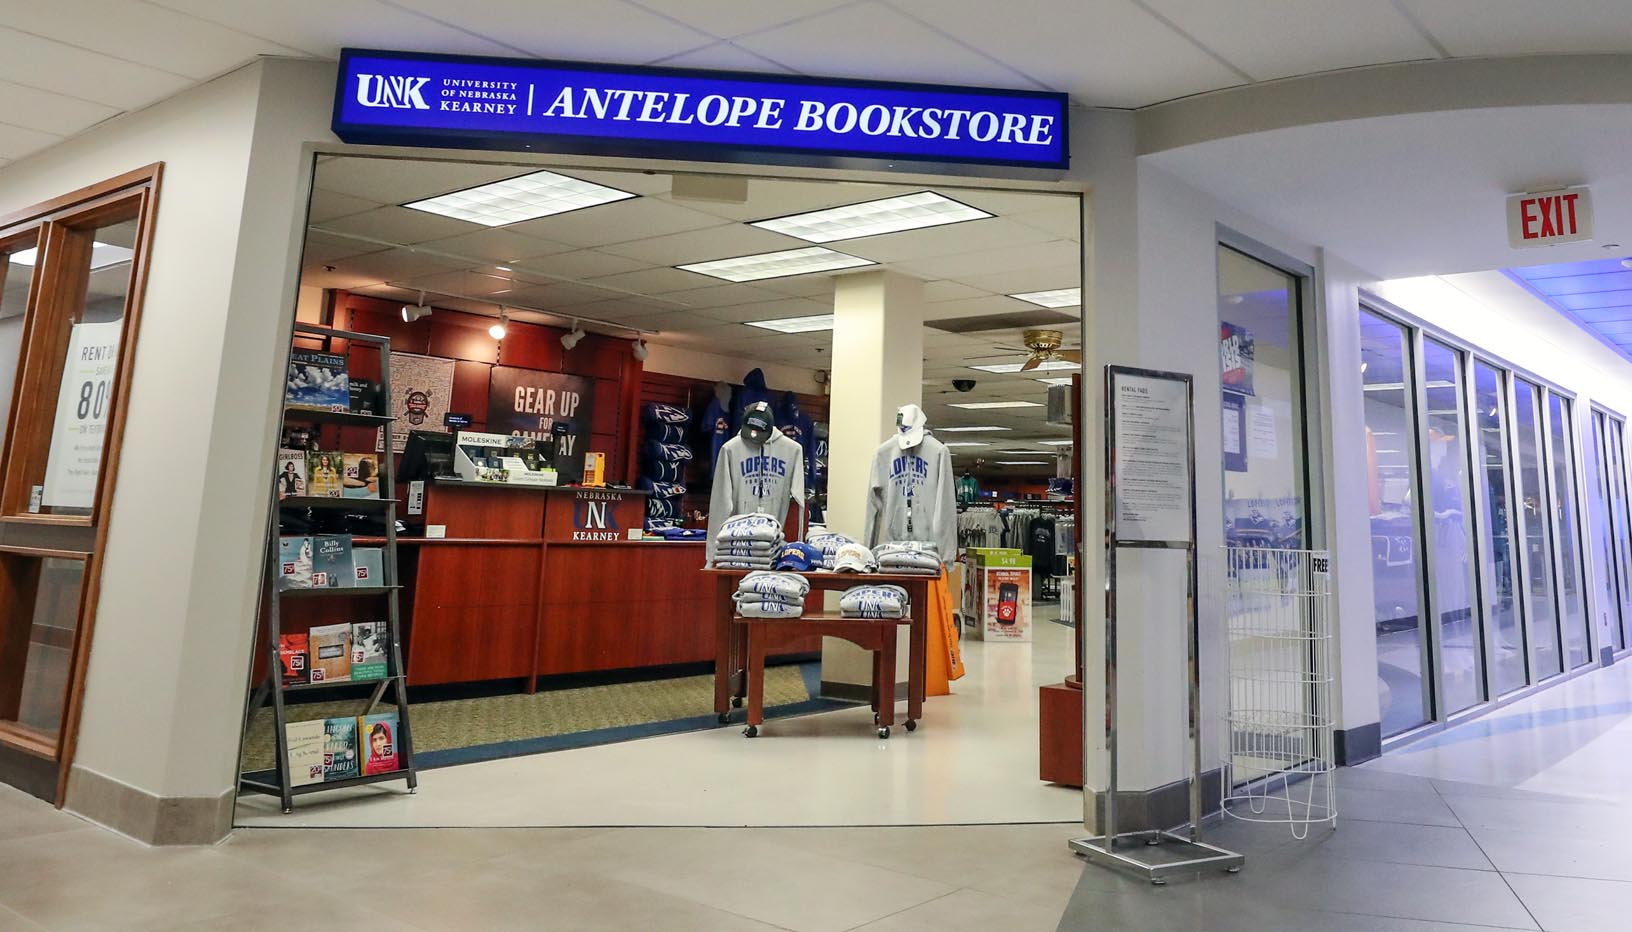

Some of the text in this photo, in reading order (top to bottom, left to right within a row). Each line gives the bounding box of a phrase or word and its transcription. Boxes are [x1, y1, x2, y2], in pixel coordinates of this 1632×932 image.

[443, 78, 518, 90] UNIVERSITY
[356, 73, 431, 110] UNK
[441, 88, 517, 101] OF NEBRASKA
[439, 101, 518, 115] KEARNEY
[543, 86, 1054, 145] ANTELOPE BOOKSTORE
[1520, 193, 1579, 240] EXIT
[81, 345, 107, 361] RENT
[311, 354, 345, 366] PLAINS
[514, 386, 580, 418] GEAR UP
[539, 416, 553, 430] FOR
[461, 436, 502, 445] MOLESKINE
[740, 455, 787, 477] LOPERS
[576, 491, 623, 501] NEBRASKA
[573, 531, 620, 541] KEARNEY
[319, 546, 344, 554] Collins
[324, 540, 340, 549] Billy
[1313, 558, 1328, 573] FREE
